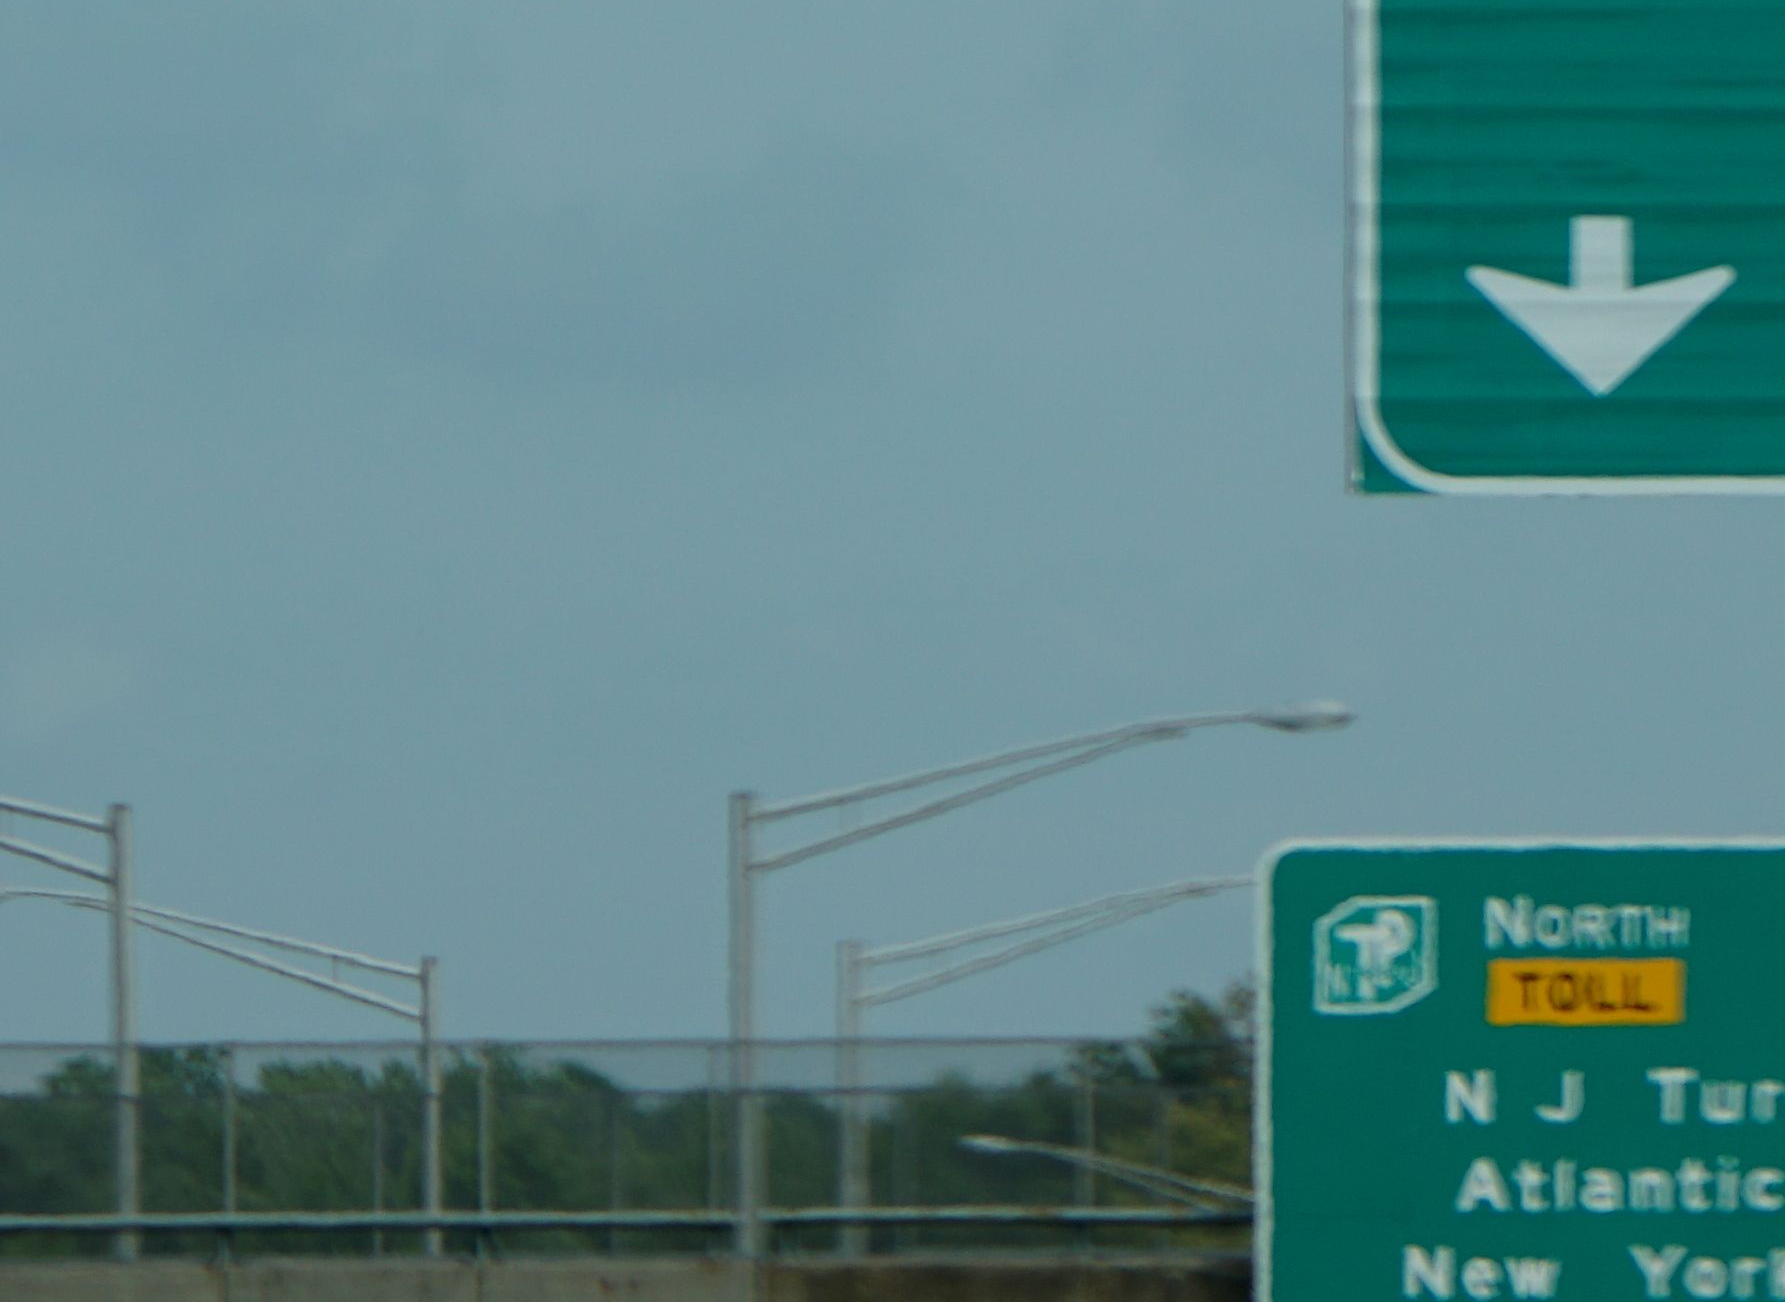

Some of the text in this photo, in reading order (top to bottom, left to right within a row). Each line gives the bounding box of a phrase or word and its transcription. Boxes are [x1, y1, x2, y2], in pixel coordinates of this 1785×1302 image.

[1483, 894, 1690, 948] NORTH
[1513, 969, 1658, 1014] TOLL
[1445, 1068, 1495, 1124] N
[1536, 1069, 1585, 1123] J
[1456, 1156, 1784, 1212] Atlantic
[1403, 1244, 1560, 1299] New
